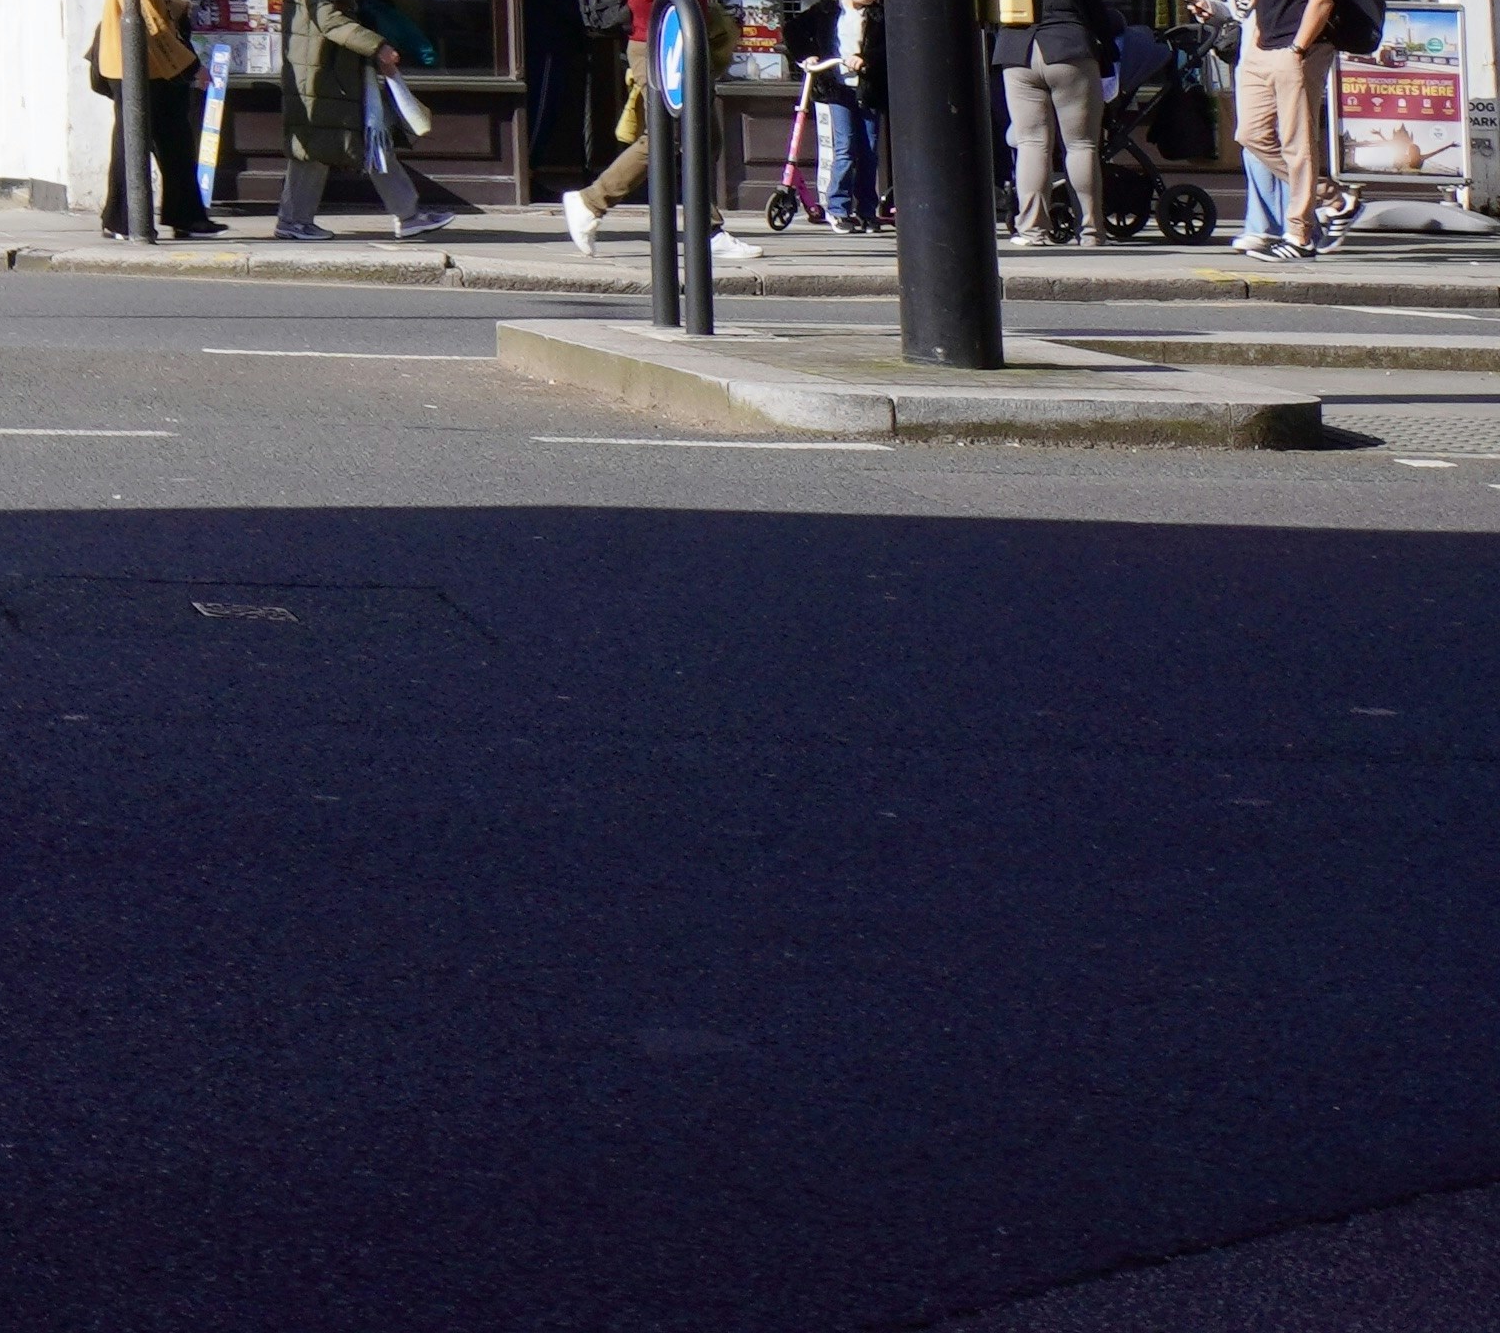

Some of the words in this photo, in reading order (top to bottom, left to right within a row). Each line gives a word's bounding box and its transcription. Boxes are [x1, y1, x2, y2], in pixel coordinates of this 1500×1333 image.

[1342, 83, 1367, 94] BUY
[1369, 84, 1420, 96] TICKETS
[1421, 85, 1455, 97] HERE
